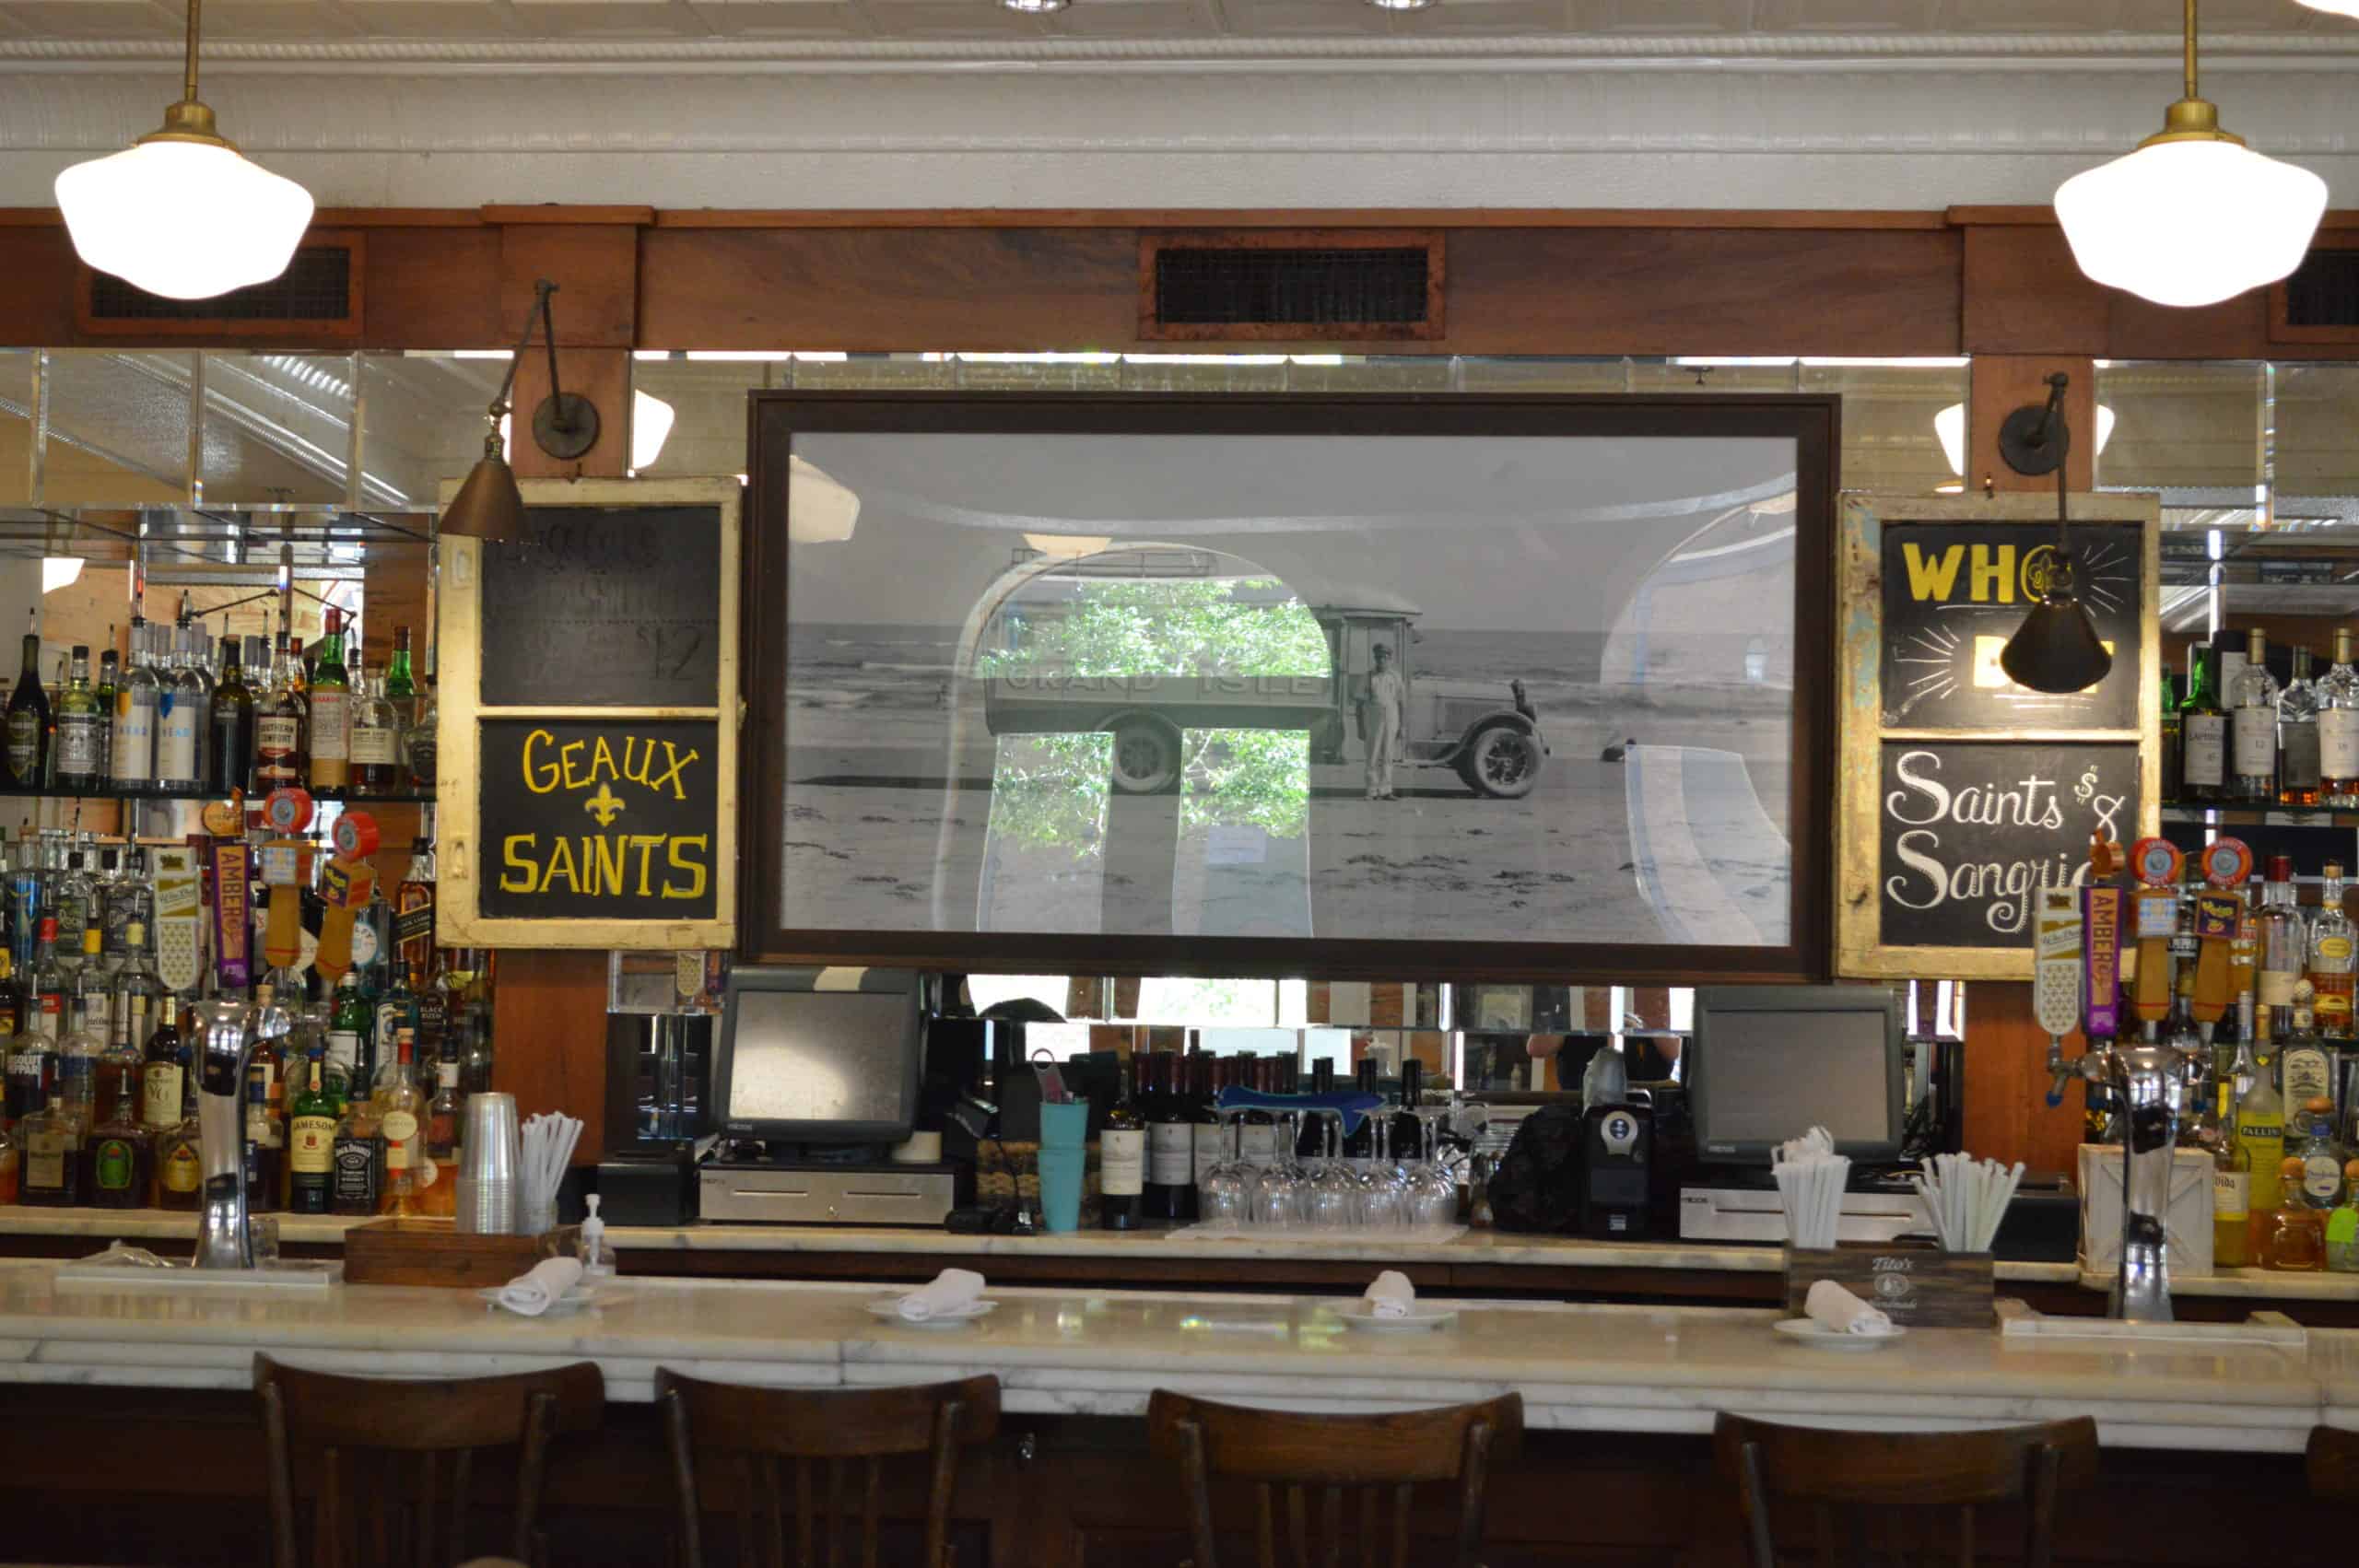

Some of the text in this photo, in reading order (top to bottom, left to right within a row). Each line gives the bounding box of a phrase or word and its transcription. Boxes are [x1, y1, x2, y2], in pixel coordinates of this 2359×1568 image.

[522, 729, 699, 801] GEAUX
[1887, 751, 2064, 830] Saints
[220, 851, 243, 917] AMBER
[499, 832, 708, 899] SAINTS
[2093, 895, 2117, 963] AMBER
[294, 1117, 334, 1130] JAMESON
[2214, 1176, 2236, 1189] Vida
[1872, 1257, 1916, 1271] Tito's
